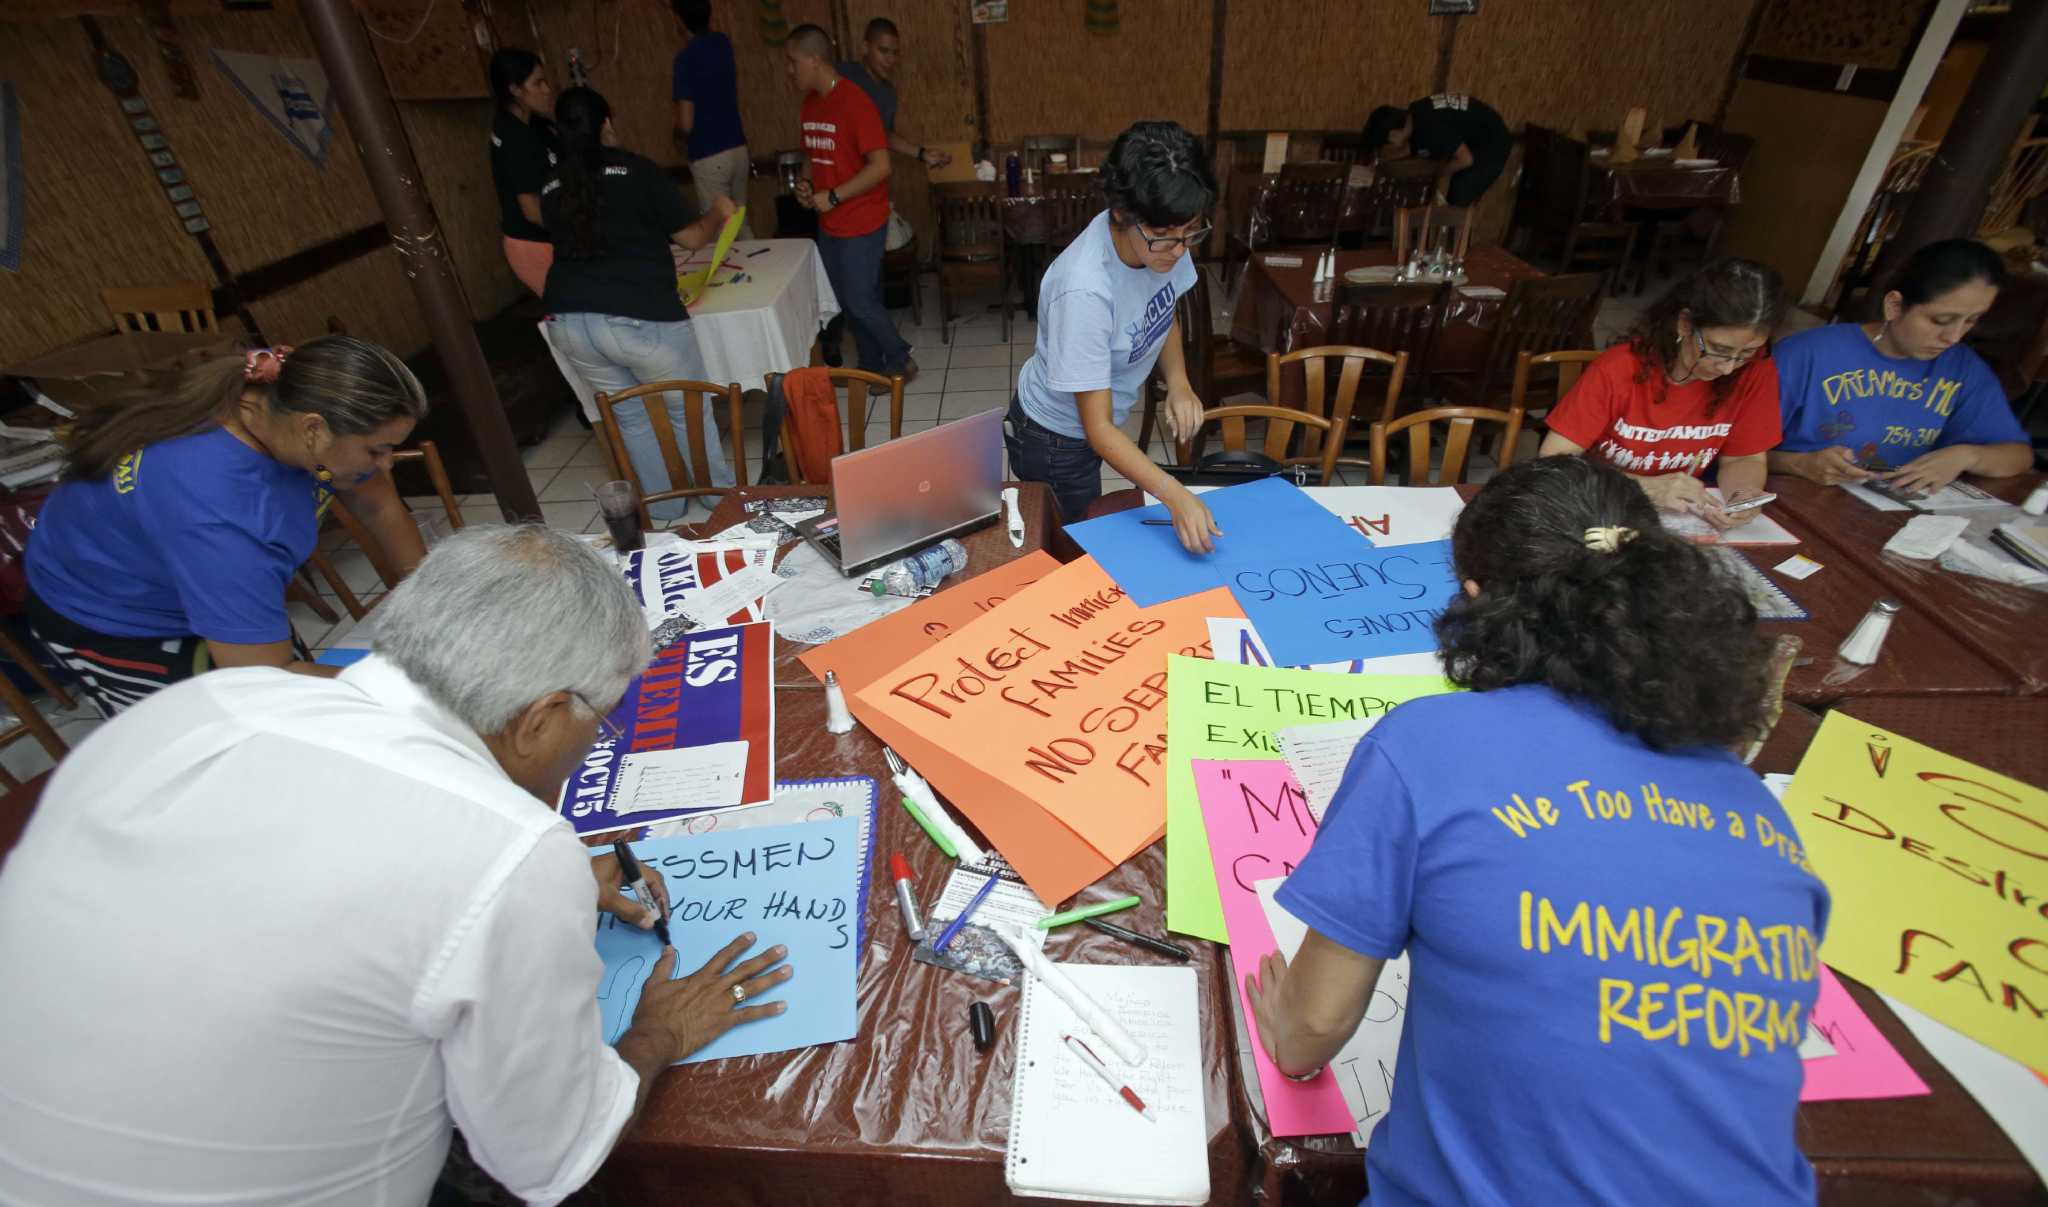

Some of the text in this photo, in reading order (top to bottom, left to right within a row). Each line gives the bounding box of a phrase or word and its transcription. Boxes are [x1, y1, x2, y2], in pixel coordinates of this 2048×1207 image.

[685, 634, 738, 687] ES
[1204, 681, 1254, 708] EL
[1025, 738, 1096, 783] NO
[1491, 794, 1559, 838] We
[1567, 780, 1632, 820] Too
[1641, 783, 1714, 831] Have
[1727, 811, 1746, 838] a
[1520, 890, 1818, 982] IMMIGRATIO
[1599, 978, 1800, 1057] REFORM
